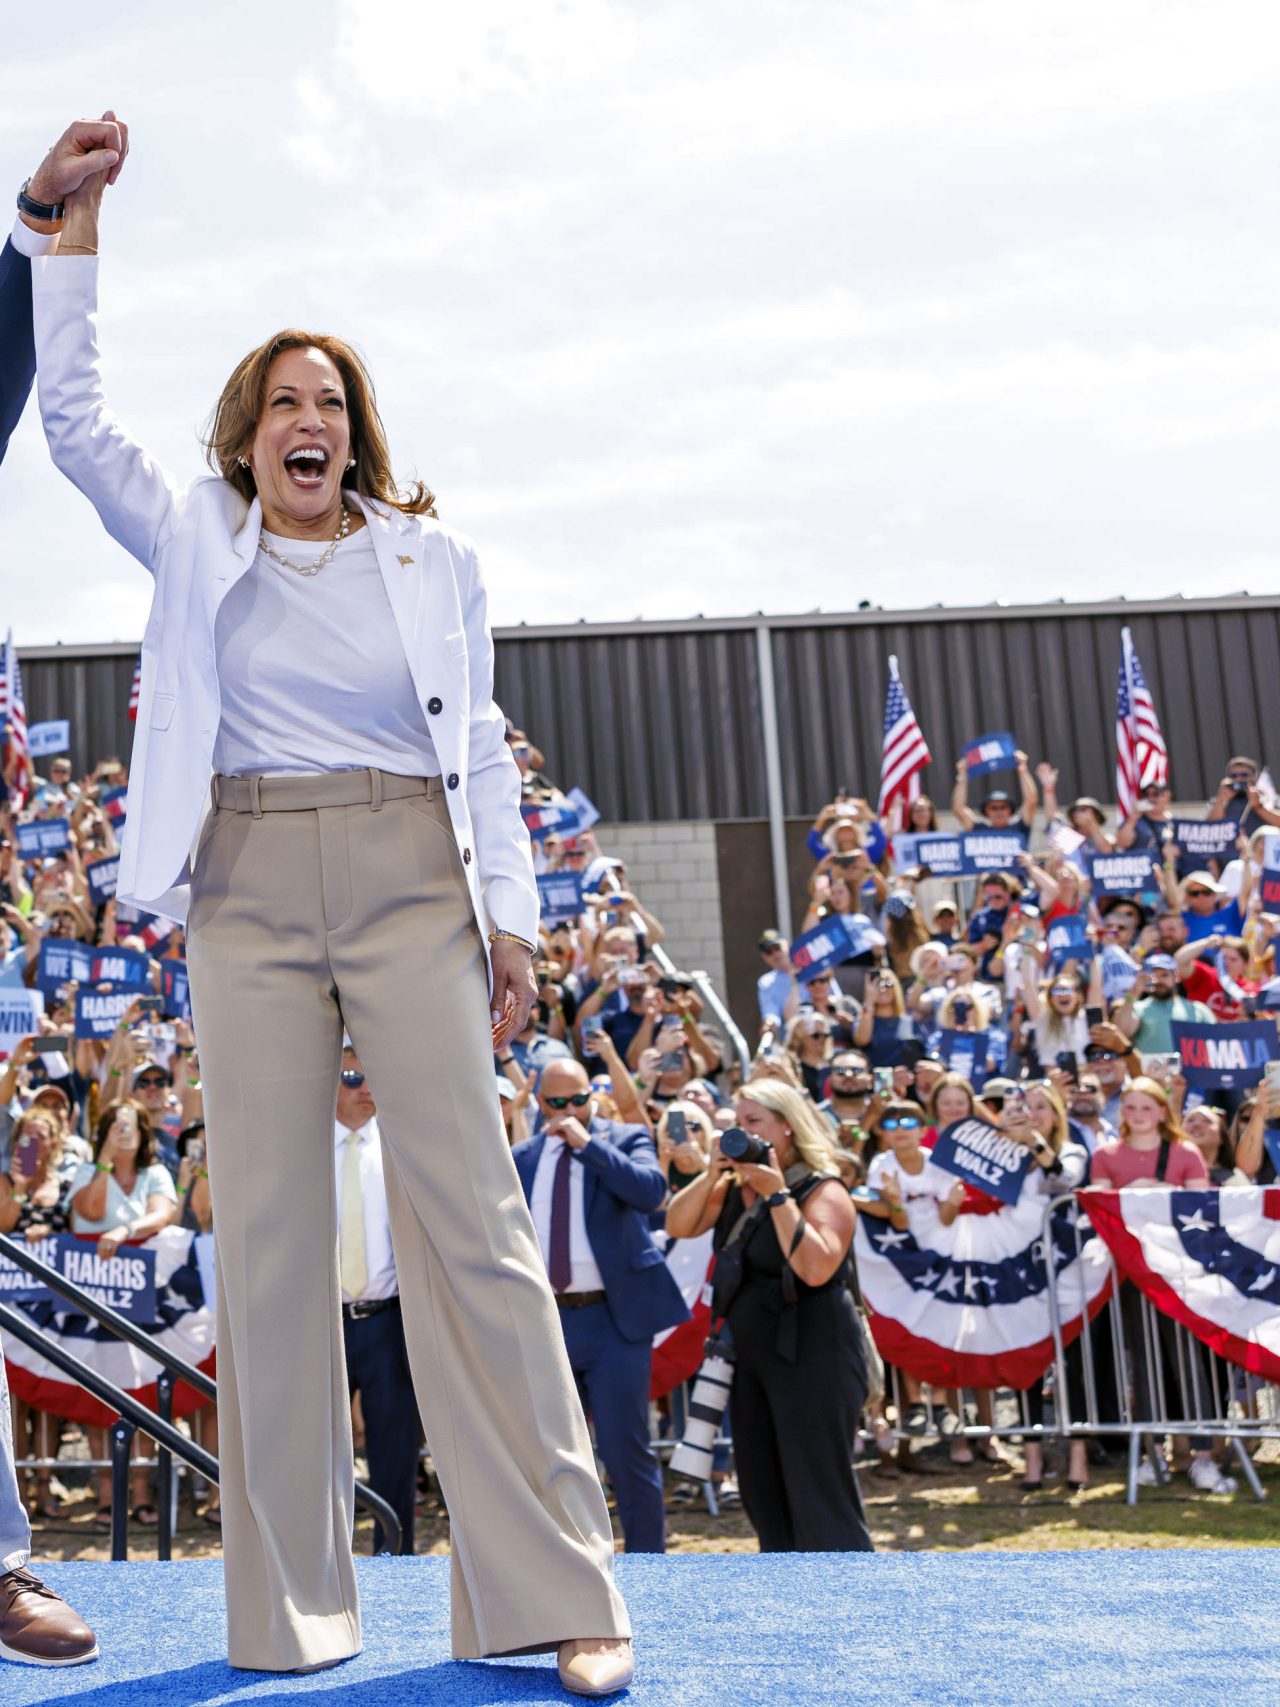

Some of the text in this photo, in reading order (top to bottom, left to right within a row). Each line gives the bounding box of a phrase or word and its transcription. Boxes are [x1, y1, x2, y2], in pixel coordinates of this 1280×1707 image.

[1177, 822, 1236, 842] HARRIS
[1093, 855, 1152, 879] HARRIS
[92, 956, 142, 984] AMALA
[1180, 1036, 1270, 1070] KAMALA
[950, 1119, 1030, 1174] HARRIS
[952, 1148, 1005, 1187] WALZ
[63, 1250, 147, 1291] HARRIS
